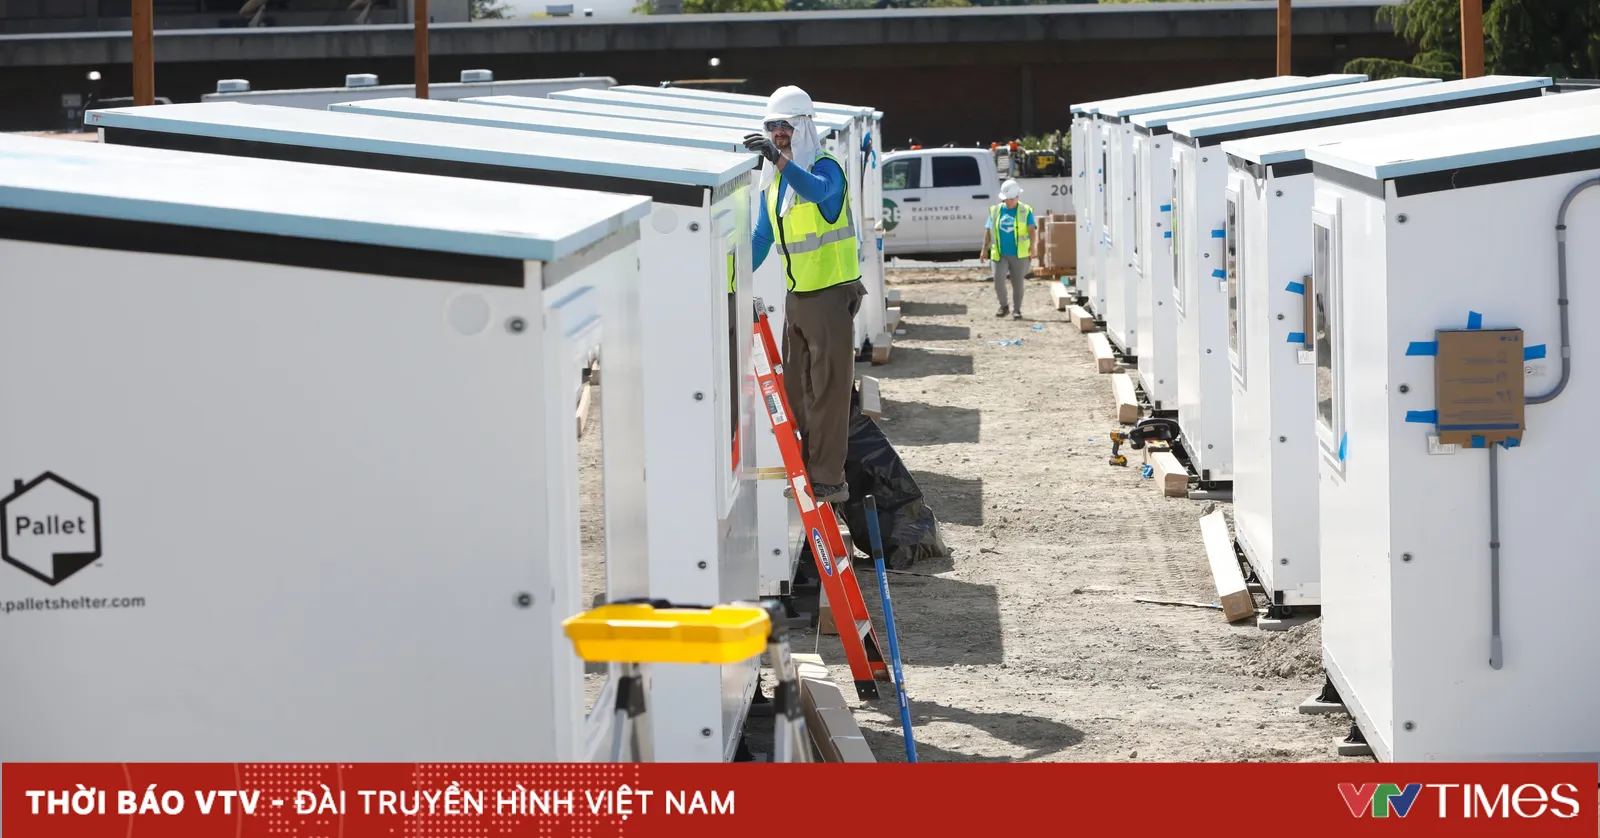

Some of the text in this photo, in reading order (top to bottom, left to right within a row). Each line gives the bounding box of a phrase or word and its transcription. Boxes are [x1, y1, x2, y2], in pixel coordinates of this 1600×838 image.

[1051, 184, 1073, 196] 20
[911, 205, 961, 213] RAINSTATE
[912, 214, 973, 222] EARTHWORKS
[15, 514, 86, 536] Pallet
[815, 537, 830, 568] WERNER
